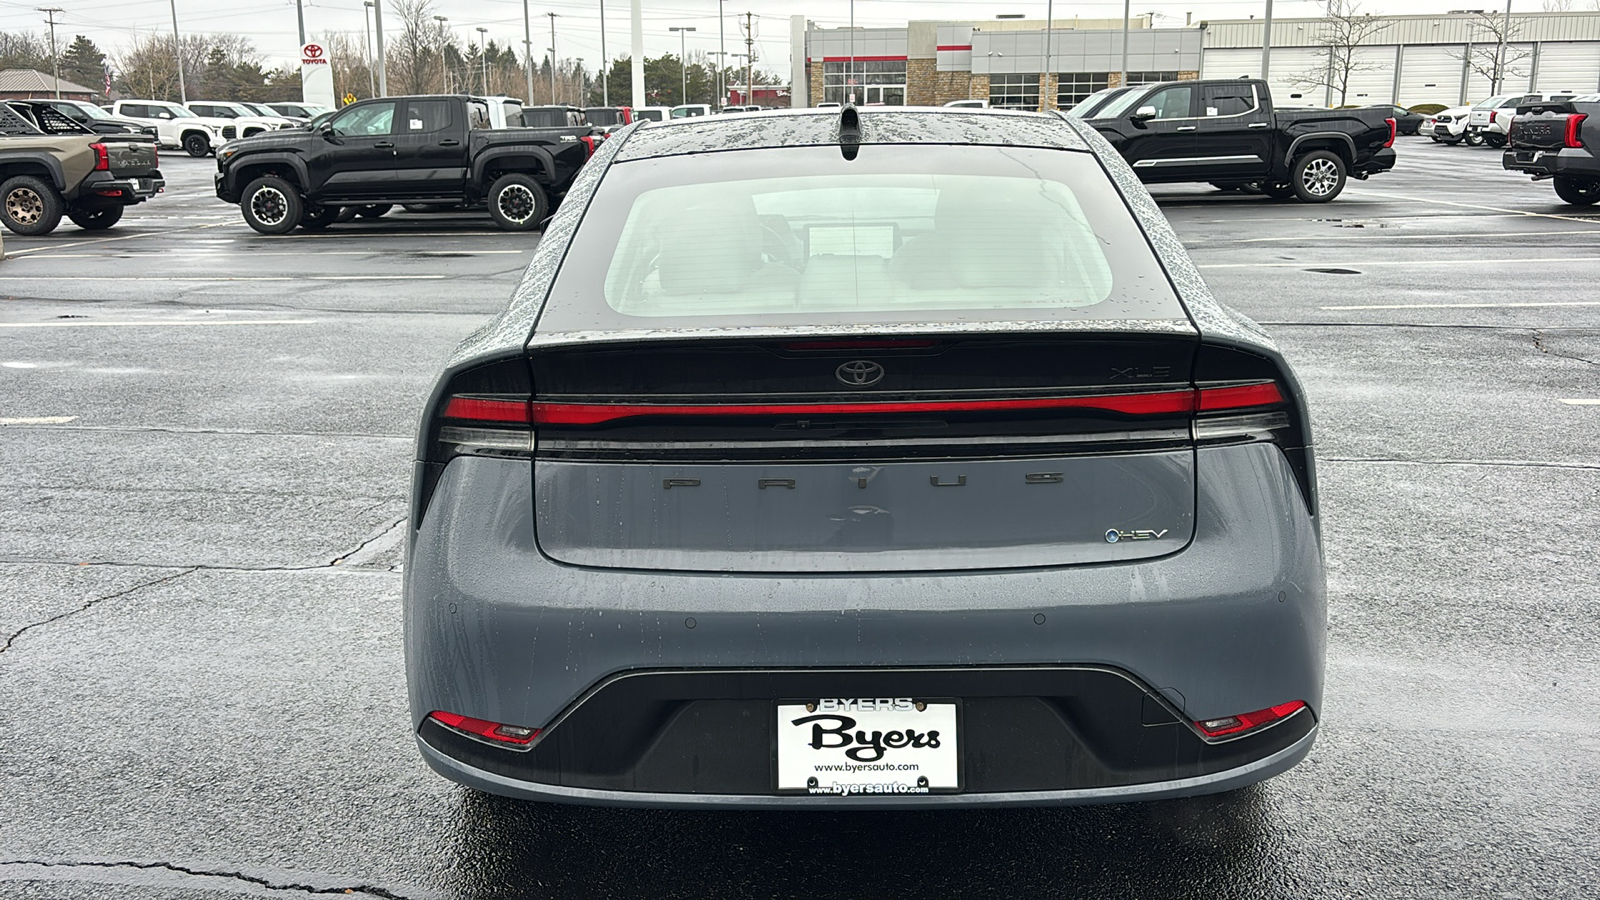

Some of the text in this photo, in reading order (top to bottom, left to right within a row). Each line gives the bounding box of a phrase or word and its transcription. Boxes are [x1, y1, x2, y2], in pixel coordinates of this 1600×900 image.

[1109, 366, 1171, 380] XLE
[1118, 529, 1169, 540] HEV
[819, 697, 914, 712] BYERS
[791, 714, 941, 763] Byers
[814, 762, 919, 774] www.byersauto.com
[808, 781, 929, 796] www.byersauto.com
